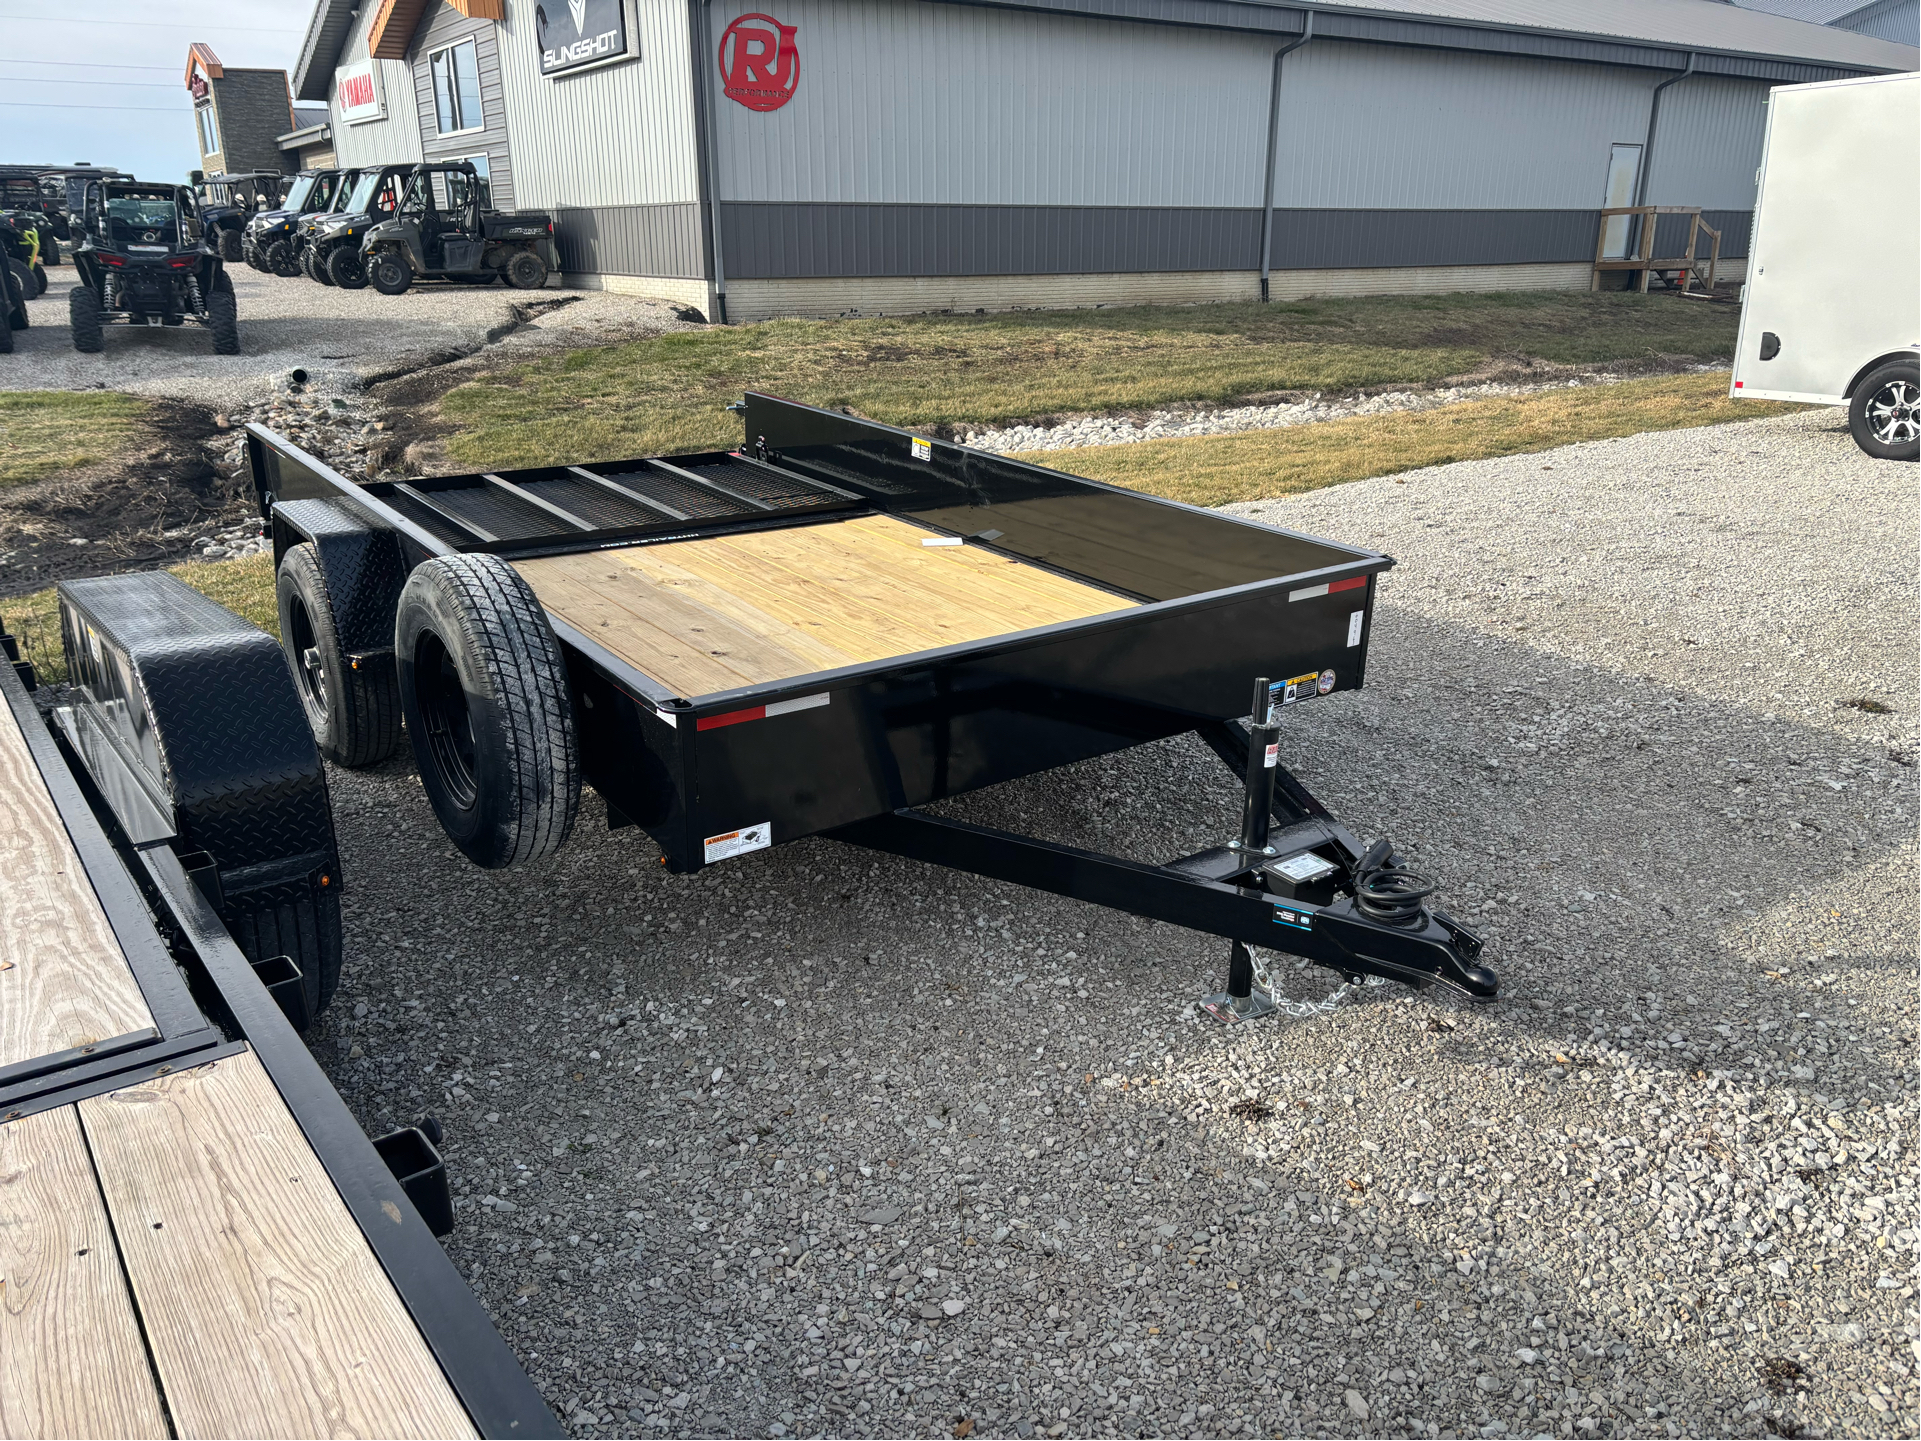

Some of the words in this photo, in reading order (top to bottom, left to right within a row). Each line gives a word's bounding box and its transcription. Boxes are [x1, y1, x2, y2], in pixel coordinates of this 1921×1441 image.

[543, 29, 618, 68] SLINGSHOT
[344, 73, 375, 108] YAMAHA
[727, 87, 790, 98] PERFORMANCE
[1296, 675, 1313, 683] CAUTION
[711, 833, 736, 843] WARNING
